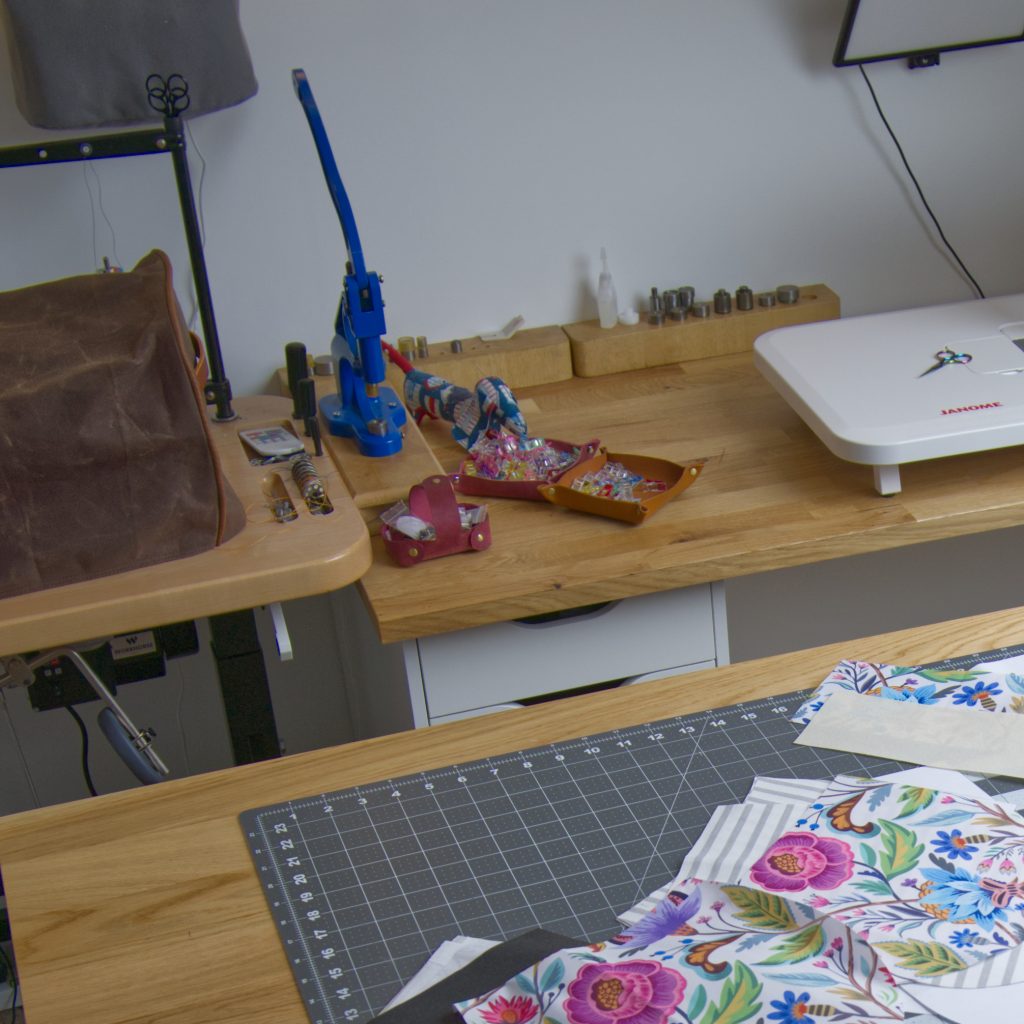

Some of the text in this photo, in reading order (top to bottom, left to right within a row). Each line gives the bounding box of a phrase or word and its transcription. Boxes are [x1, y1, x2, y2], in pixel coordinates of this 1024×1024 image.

[940, 402, 1003, 415] JANOME
[274, 823, 287, 834] 23
[280, 839, 294, 850] 22
[287, 857, 300, 867] 21
[293, 874, 307, 885] 20
[300, 892, 313, 902] 19
[307, 910, 320, 921] 18
[314, 930, 328, 939] 17
[321, 948, 335, 959] 16
[329, 968, 343, 979] 15
[336, 988, 351, 1000] 14
[344, 1008, 358, 1020] 13
